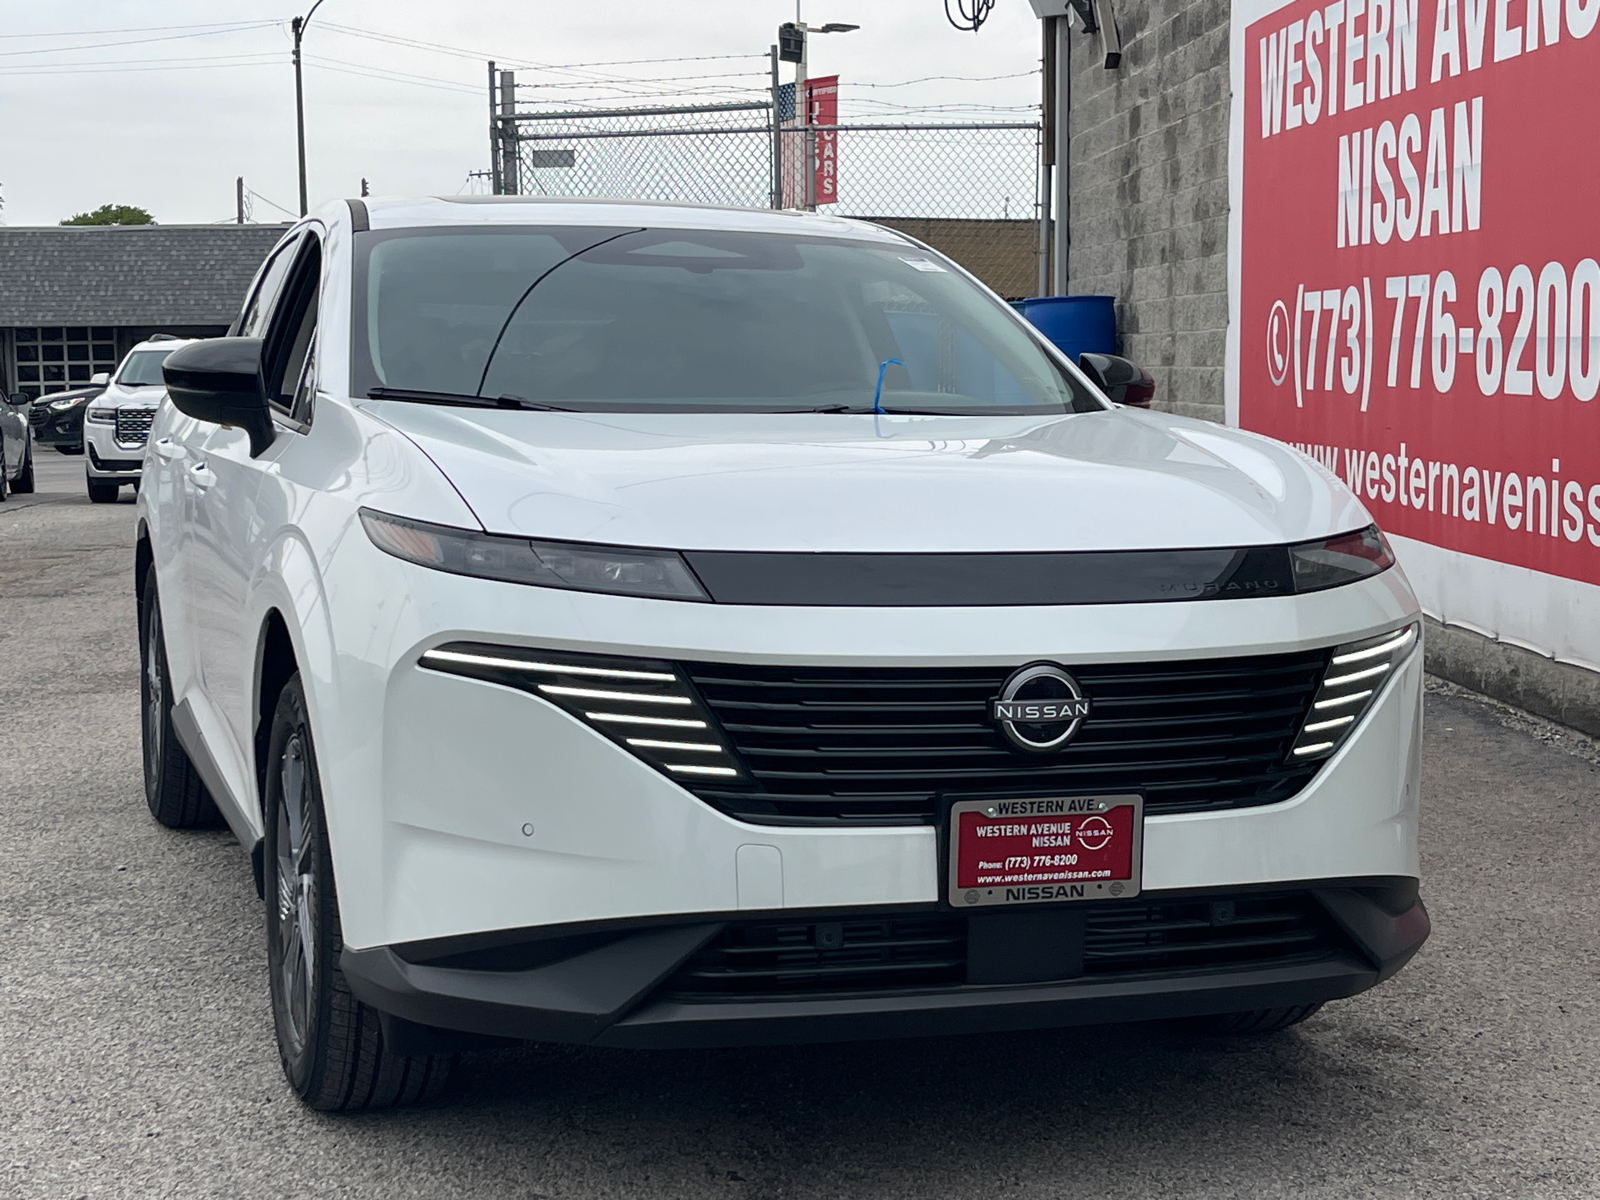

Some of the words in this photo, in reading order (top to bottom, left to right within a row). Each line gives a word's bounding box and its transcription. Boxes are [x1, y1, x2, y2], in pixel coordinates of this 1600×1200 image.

[1259, 0, 1419, 139] WESTERN
[1337, 96, 1483, 248] NISSAN
[1294, 277, 1372, 412] (773)
[1385, 258, 1600, 402] 776-8200
[997, 702, 1089, 719] NISSAN
[998, 800, 1064, 815] WESTERN
[976, 824, 1028, 837] WESTERN
[1029, 822, 1071, 835] AVENUE
[1075, 829, 1114, 837] NISSAN
[1032, 835, 1071, 848] NISSAN
[978, 861, 1003, 869] Phone:
[1005, 857, 1031, 871] (773)
[1033, 854, 1078, 867] 776-8200
[977, 869, 1111, 884] www.westernavenissan.com
[1006, 884, 1085, 901] NISSAN
